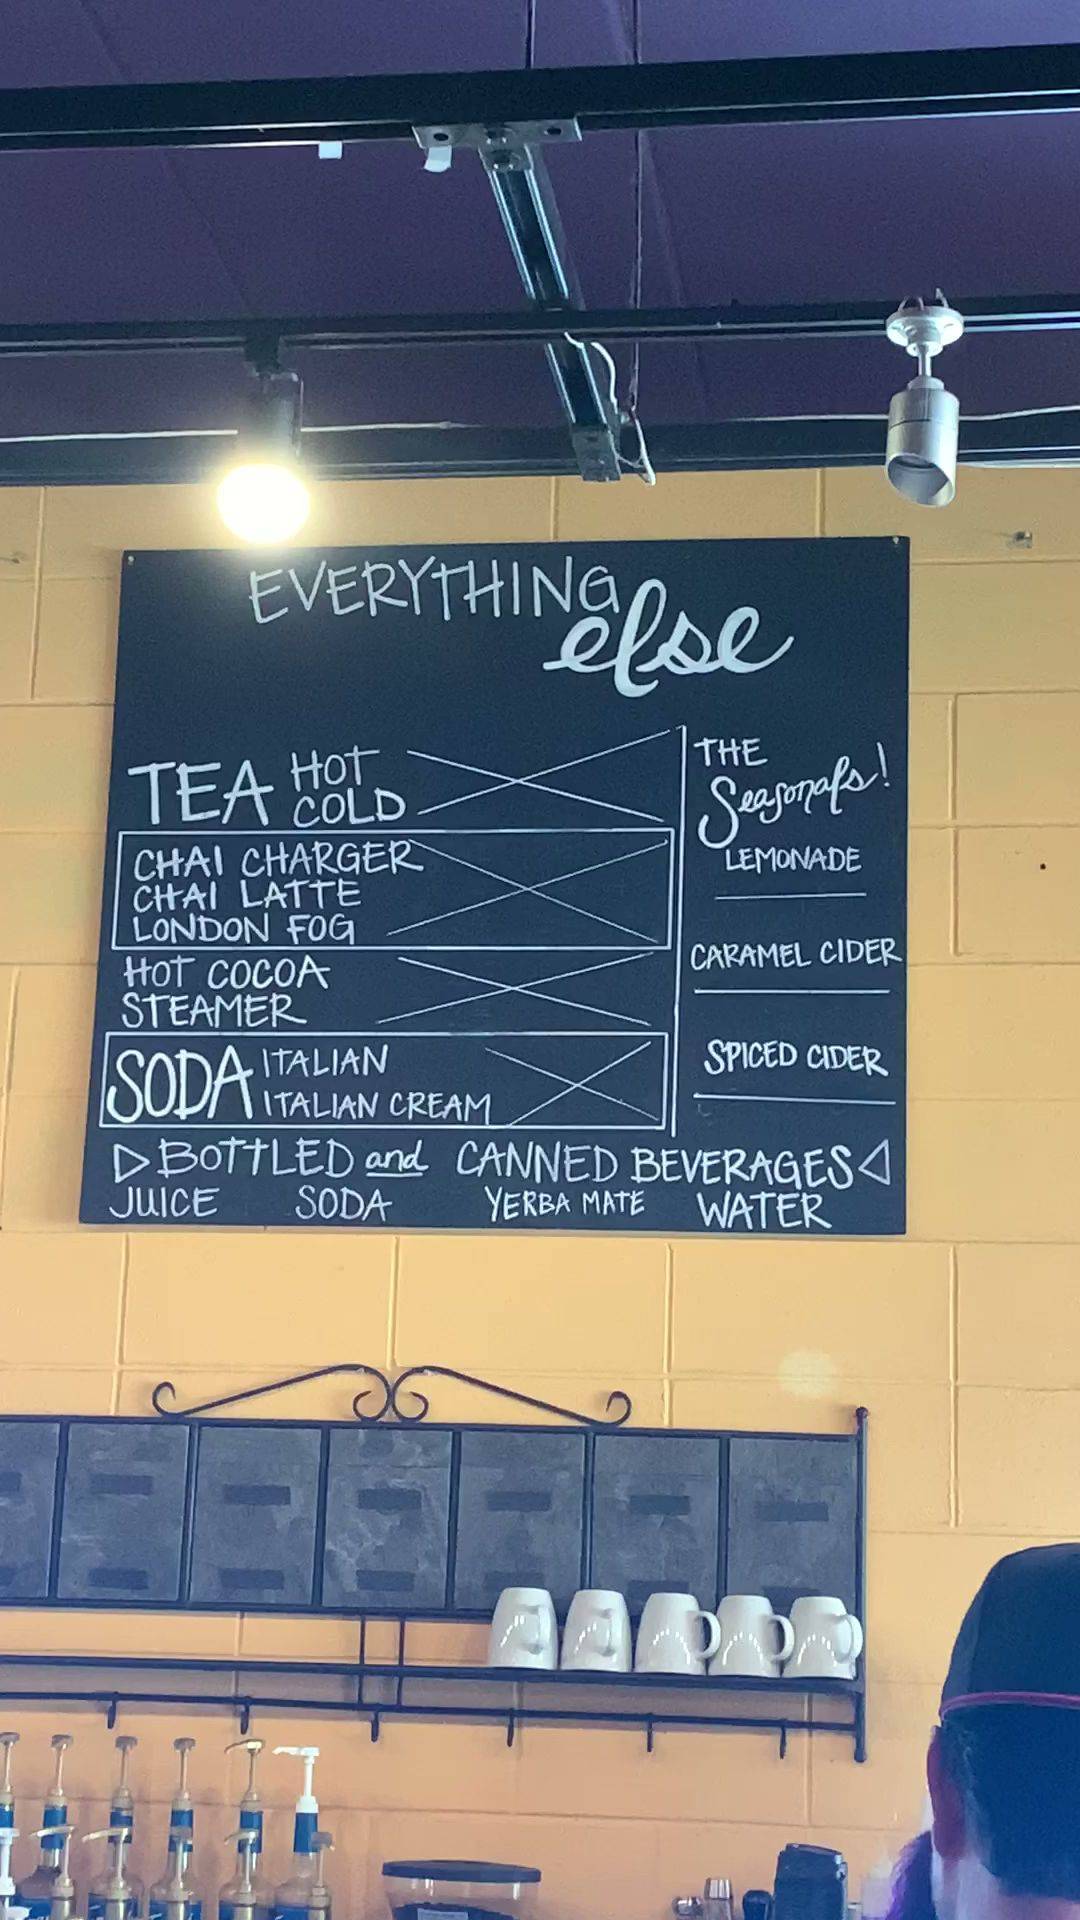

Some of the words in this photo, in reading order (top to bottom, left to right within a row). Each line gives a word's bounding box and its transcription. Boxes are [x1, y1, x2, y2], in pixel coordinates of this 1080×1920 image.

[249, 555, 620, 624] EVERYTHING
[542, 578, 795, 698] else
[290, 745, 381, 792] HOT
[693, 738, 768, 767] THE
[127, 759, 275, 826] TEA
[293, 787, 406, 828] COLD
[133, 845, 224, 882] CHAI
[240, 839, 425, 877] CHARGER
[725, 846, 863, 875] LEMONADE
[133, 880, 217, 913] CHAI
[240, 878, 361, 910] LATTE
[132, 912, 270, 944] LONDON
[286, 912, 356, 946] FOG
[123, 954, 196, 988] HOT
[207, 954, 331, 990] COCOA
[690, 942, 812, 971] CARAMEL
[820, 937, 903, 968] CIDER
[121, 992, 307, 1029] STEAMER
[262, 1043, 389, 1078] ITALIAN
[704, 1038, 798, 1076] SPICED
[807, 1045, 890, 1077] CIDER
[106, 1044, 254, 1124] SODA
[263, 1090, 379, 1120] ITALIAN
[389, 1091, 491, 1126] CREAM
[157, 1136, 355, 1179] BOTTLED
[365, 1139, 430, 1172] and
[456, 1140, 619, 1184] CANNED
[630, 1143, 855, 1191] BEVERAGES
[108, 1186, 220, 1219] JUICE
[295, 1183, 393, 1222] SODA
[484, 1185, 572, 1223] YERBA
[582, 1189, 646, 1217] MATE
[696, 1191, 833, 1231] WATER
